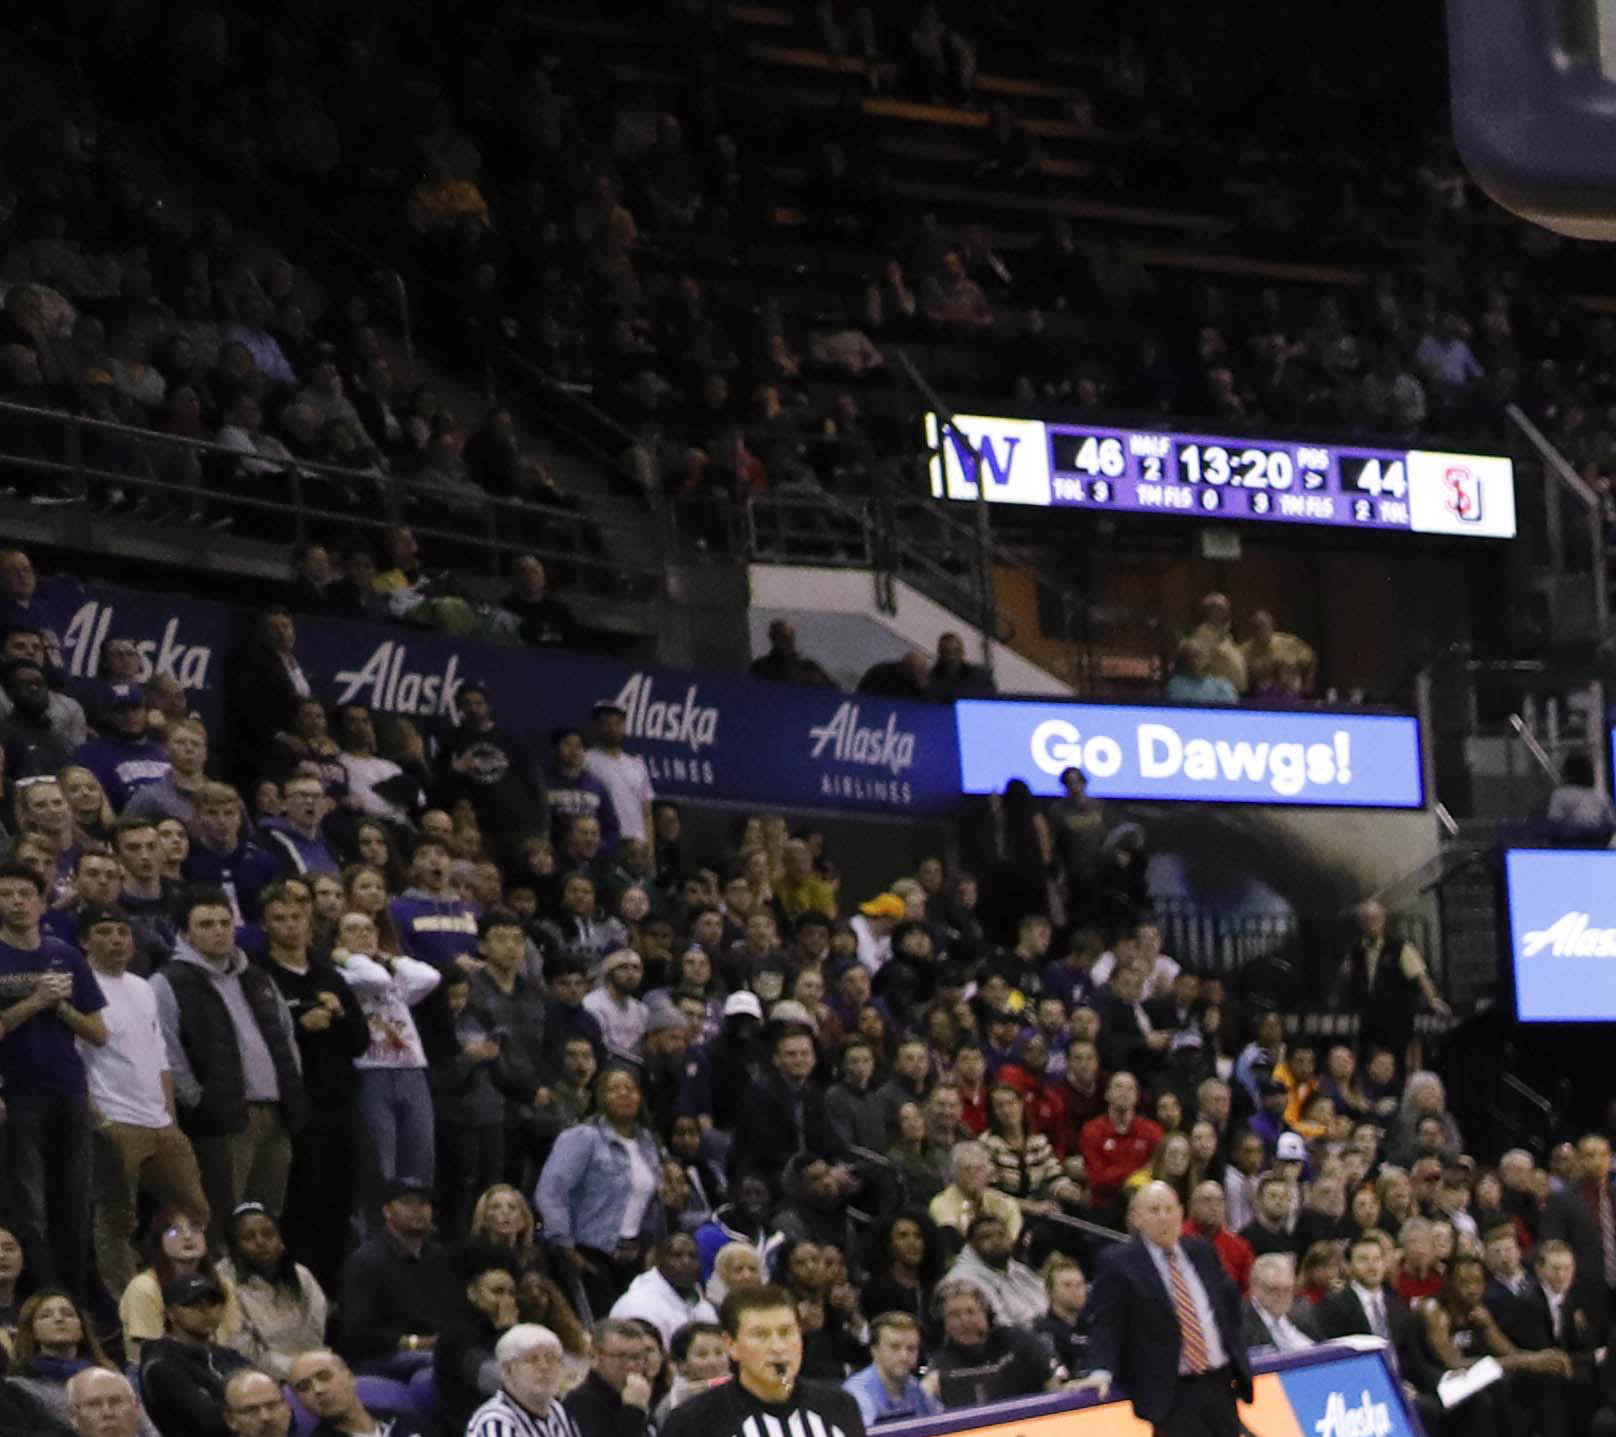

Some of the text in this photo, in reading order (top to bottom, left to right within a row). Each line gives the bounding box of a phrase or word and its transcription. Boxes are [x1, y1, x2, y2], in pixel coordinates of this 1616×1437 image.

[1075, 437, 1125, 477] 46
[1142, 457, 1162, 481] 2
[1180, 445, 1294, 490] 13:20
[1357, 458, 1407, 498] 44
[1092, 480, 1110, 502] 3
[1202, 488, 1219, 511] 0
[1253, 491, 1270, 514] 3
[63, 600, 211, 690] Alska
[333, 640, 467, 727] Alask
[615, 672, 719, 752] Alaska
[809, 701, 915, 773] Alaska
[1029, 718, 1352, 794] Go Dawgs!
